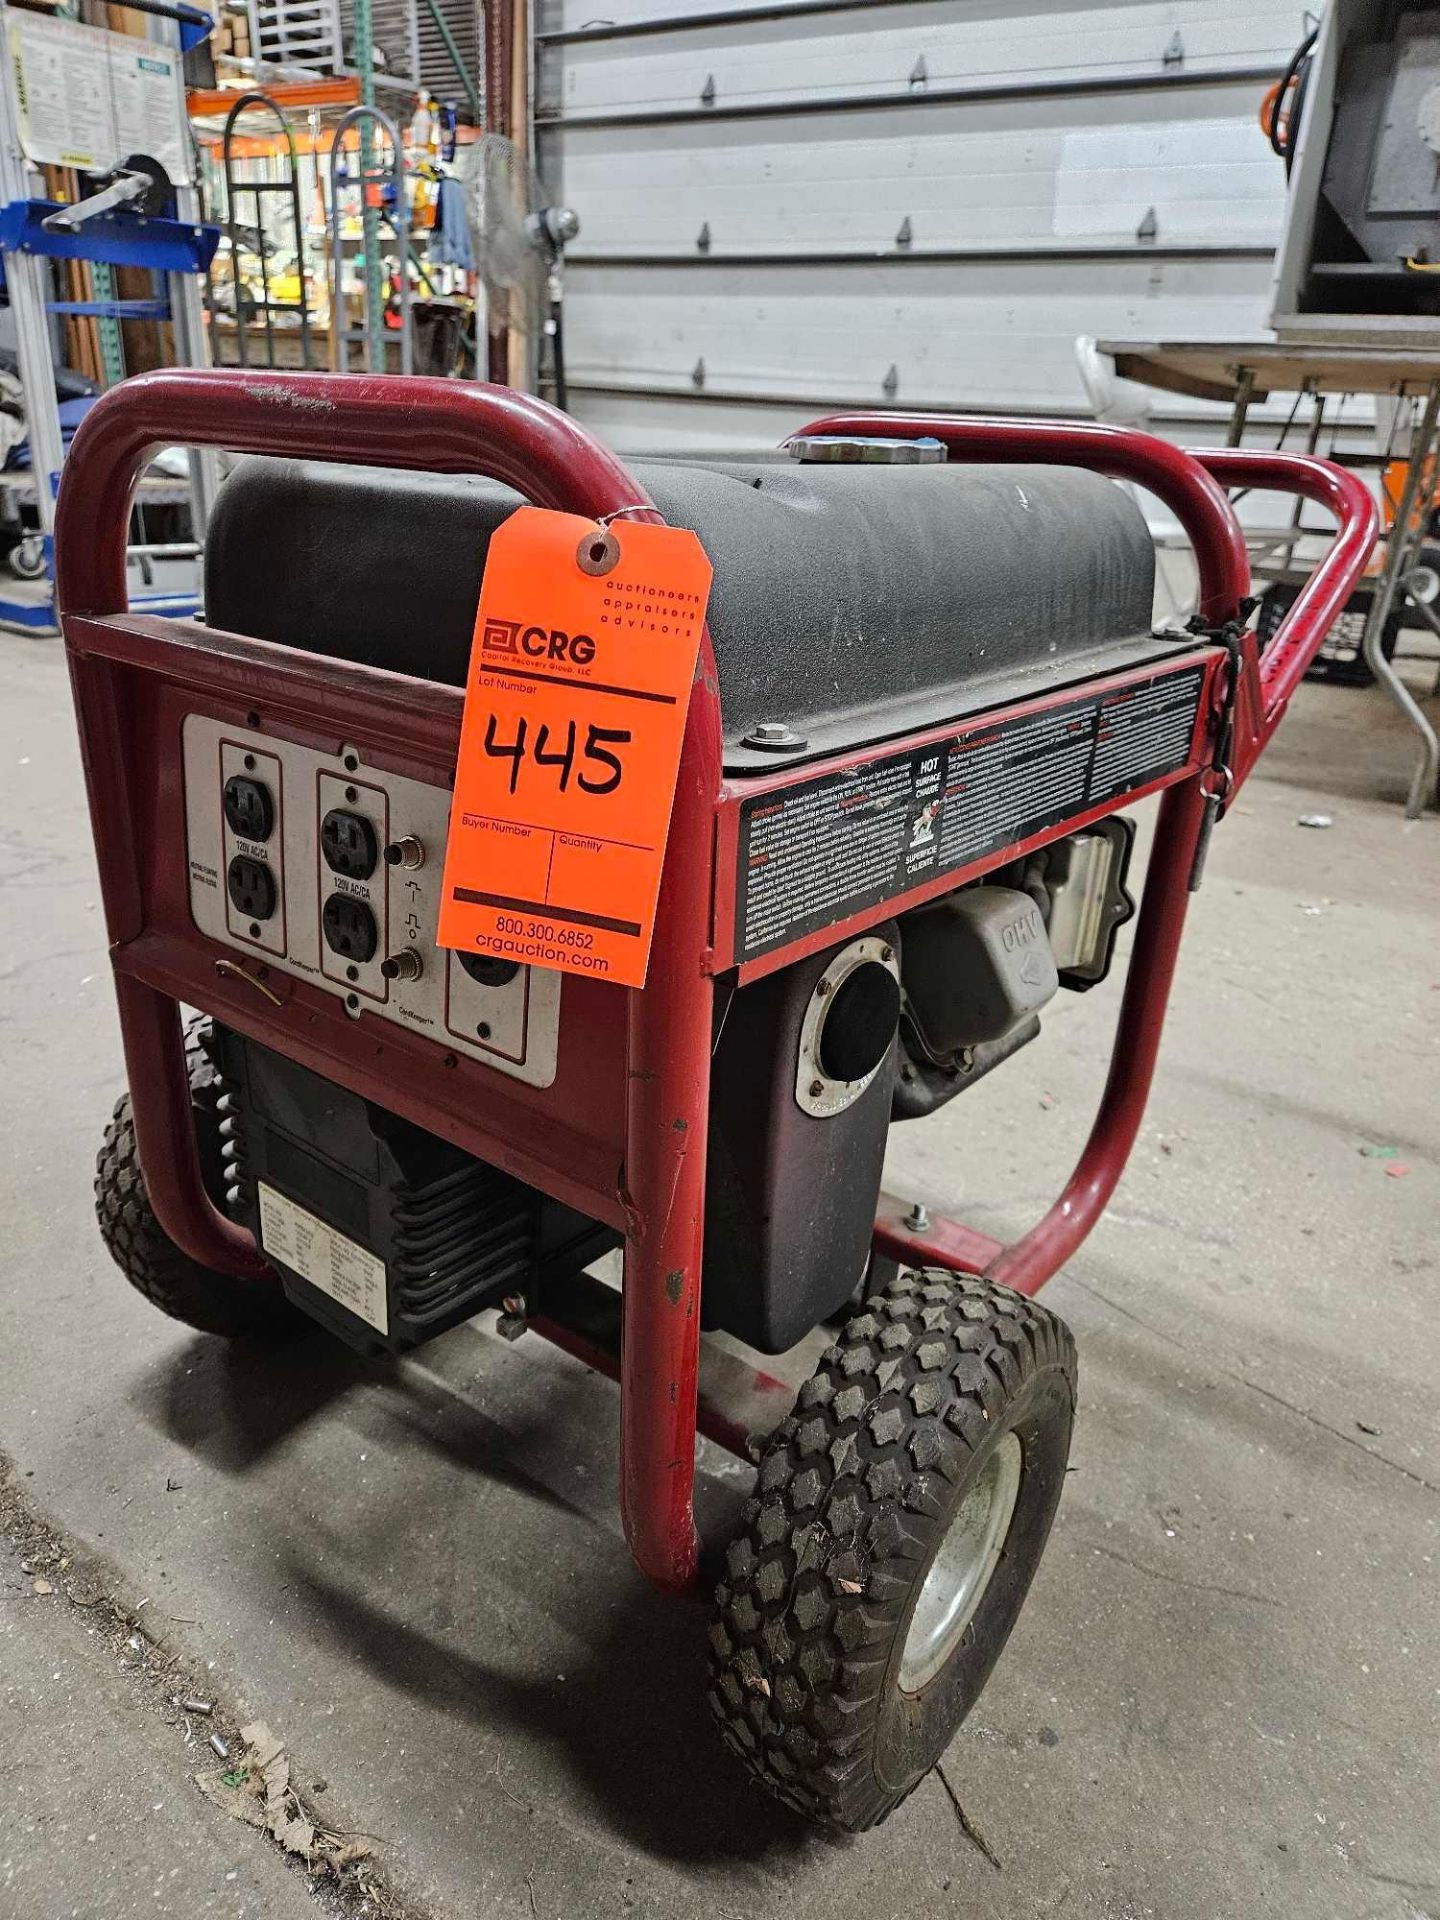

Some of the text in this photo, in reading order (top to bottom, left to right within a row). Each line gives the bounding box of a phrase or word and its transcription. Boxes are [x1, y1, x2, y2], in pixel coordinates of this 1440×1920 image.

[606, 580, 700, 603] auctioneers
[603, 598, 695, 620] appraisers
[600, 615, 691, 637] advisors
[521, 626, 596, 665] CRG
[481, 650, 510, 662] Capital
[511, 655, 547, 669] Recovery
[577, 668, 592, 677] LLC
[479, 675, 537, 695] Lot Number
[484, 713, 632, 795] 445
[920, 757, 940, 775] HOT
[915, 772, 942, 788] SURFACE
[915, 784, 940, 799] CHAUDE
[461, 816, 532, 838] Buyer Number
[236, 840, 269, 861] 120V AC/CA
[559, 834, 602, 854] Quantity
[905, 844, 938, 865] SUPERFICIE
[907, 856, 934, 874] CALIENTE
[334, 876, 371, 900] 120V AC/CA
[496, 916, 594, 950] 800.300.6852
[1002, 911, 1038, 953] OHV
[475, 933, 609, 972] crgauction.com
